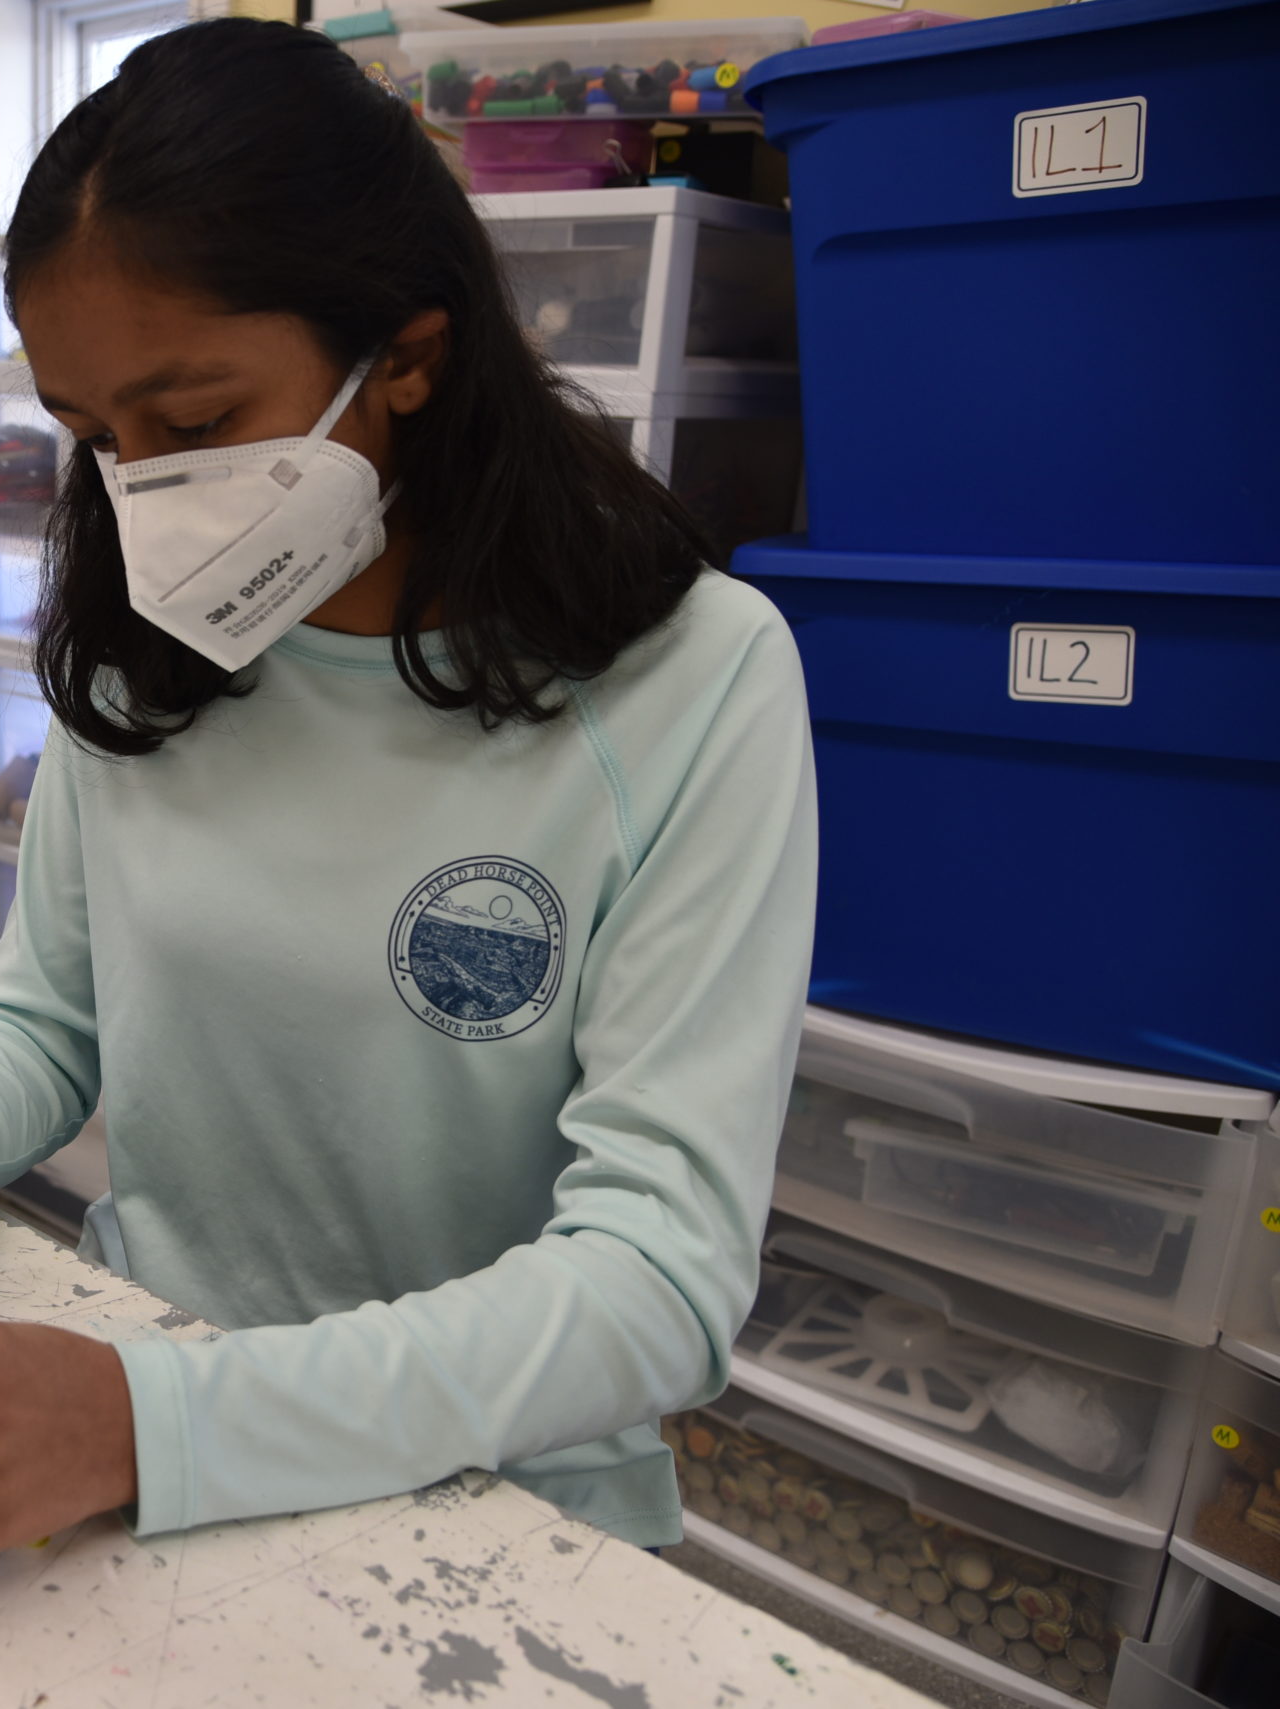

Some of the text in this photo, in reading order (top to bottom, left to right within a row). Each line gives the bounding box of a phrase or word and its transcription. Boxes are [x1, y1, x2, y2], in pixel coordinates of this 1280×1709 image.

[205, 601, 239, 625] 3M
[239, 550, 294, 600] 9502+
[424, 865, 561, 926] DEAD HORSE POINT
[421, 1006, 506, 1037] STATE PARK
[1216, 1428, 1231, 1444] M
